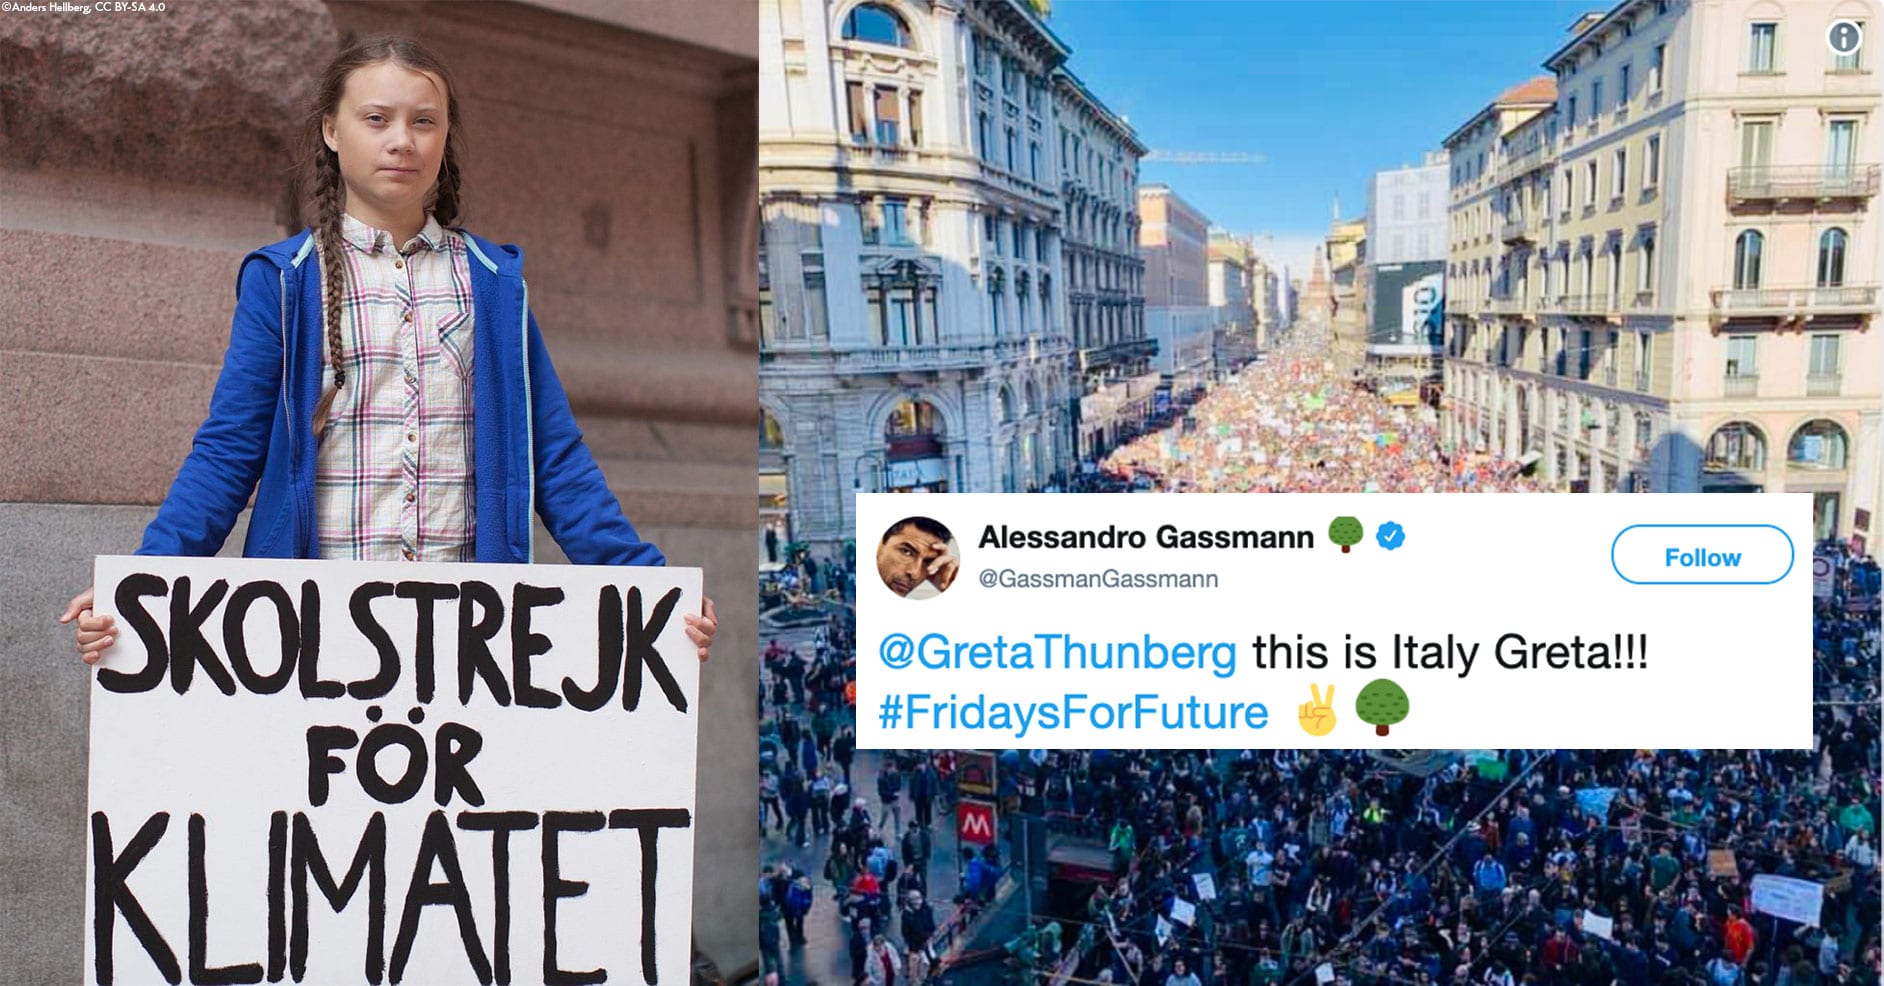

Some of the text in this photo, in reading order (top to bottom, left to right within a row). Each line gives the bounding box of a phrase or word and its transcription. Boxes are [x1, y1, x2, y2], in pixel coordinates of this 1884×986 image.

[97, 574, 687, 713] SKOLSTREJK
[307, 706, 484, 807] FÖR
[963, 812, 992, 837] M
[92, 809, 691, 986] KLIMATET
